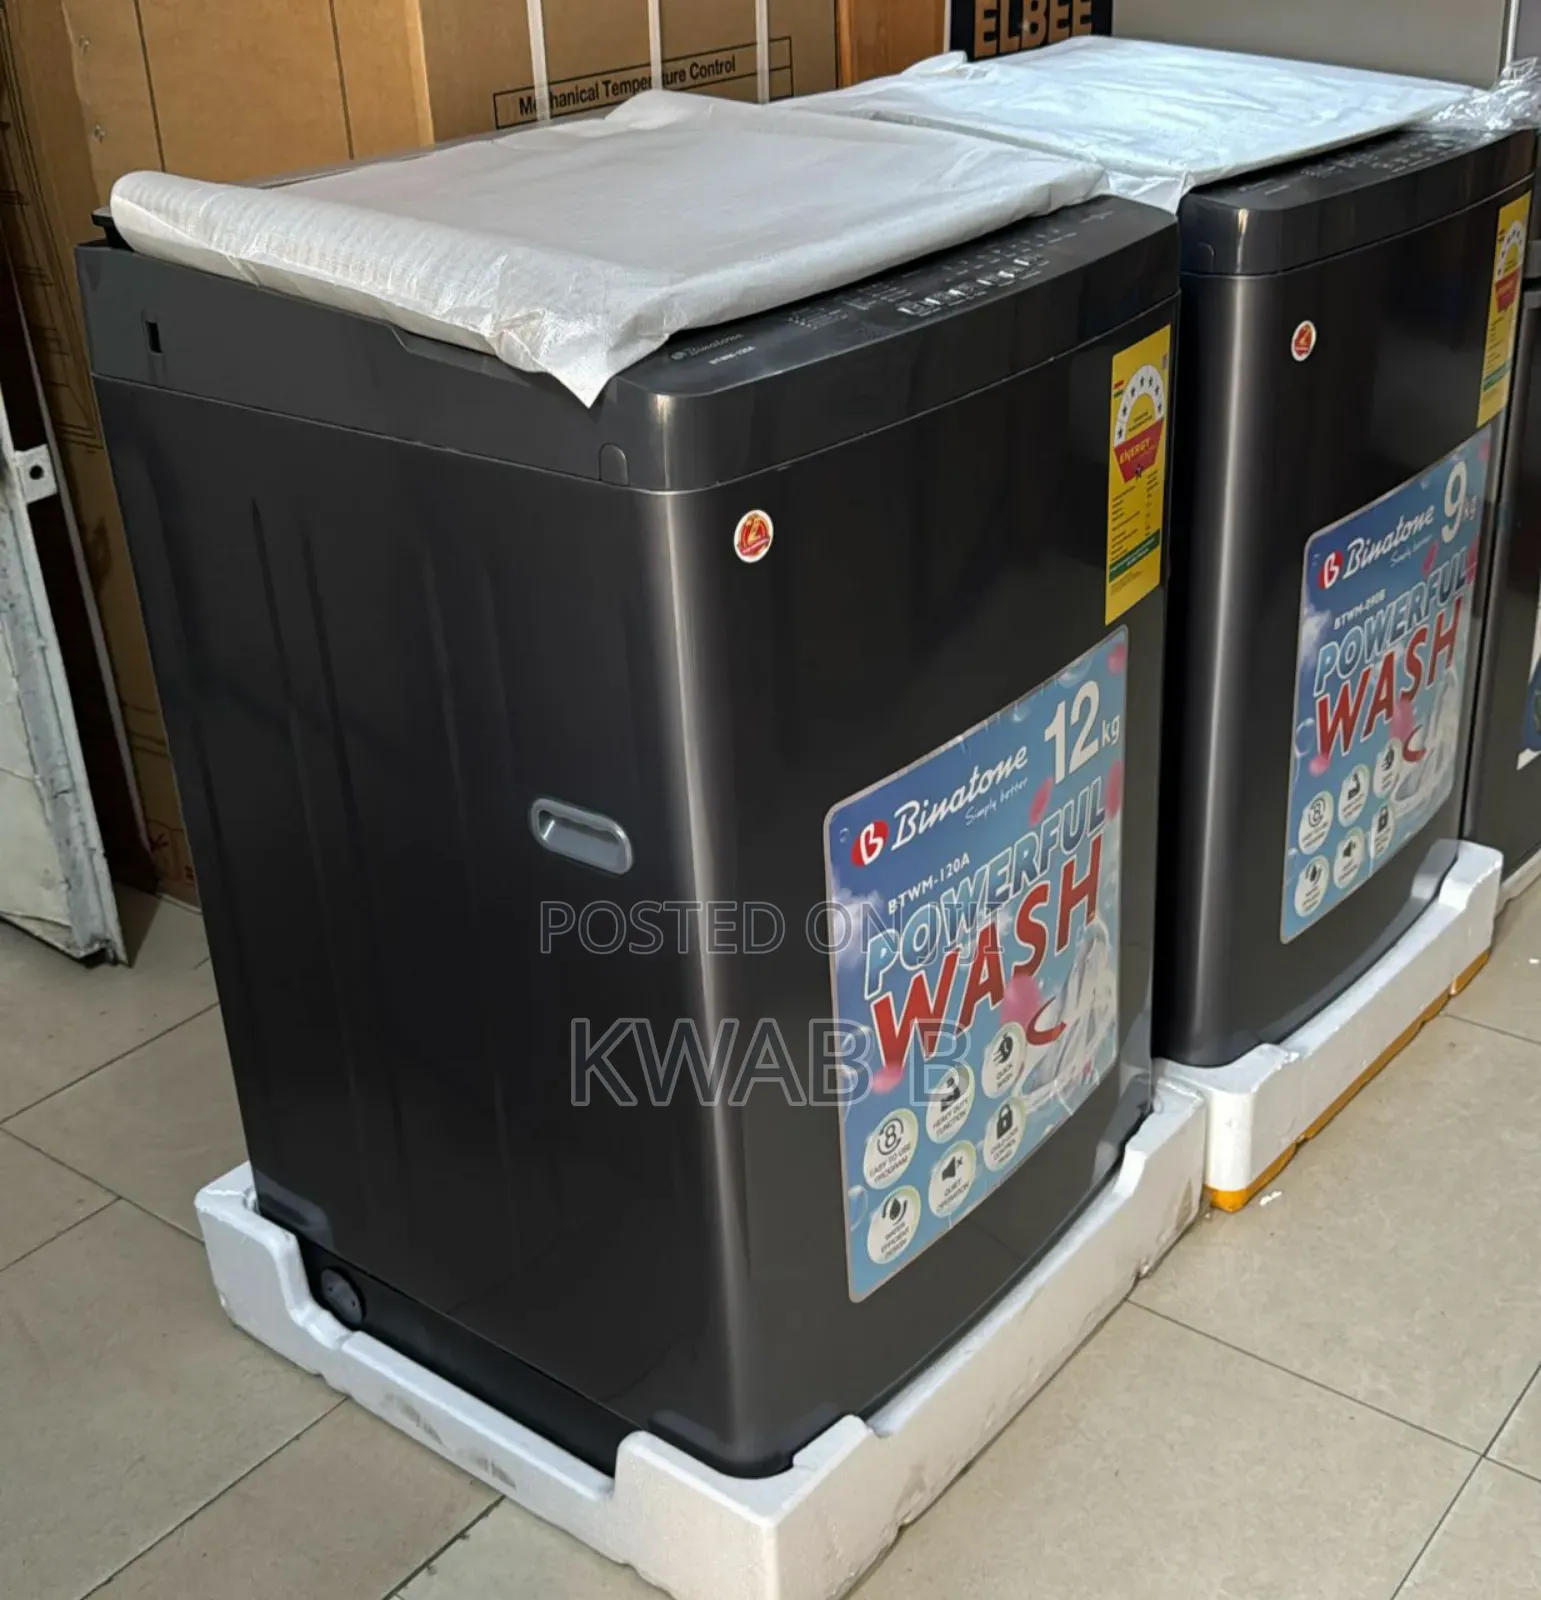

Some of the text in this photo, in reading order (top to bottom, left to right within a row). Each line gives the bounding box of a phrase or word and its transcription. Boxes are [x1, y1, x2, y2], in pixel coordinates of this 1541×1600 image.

[974, 0, 1093, 59] ELBEE
[519, 54, 736, 117] Mhanical Temperture Control
[1342, 504, 1436, 580] Binatone
[1441, 460, 1468, 544] 9
[1313, 546, 1476, 698] POWERFUL
[1315, 593, 1466, 761] WASH
[1044, 679, 1121, 785] 12 kg
[890, 745, 1029, 851] Binatone
[863, 775, 1107, 1000] POWERFUL
[887, 851, 971, 916] BTWM-120A
[869, 832, 1103, 1069] WASH
[884, 1123, 898, 1149] 8
